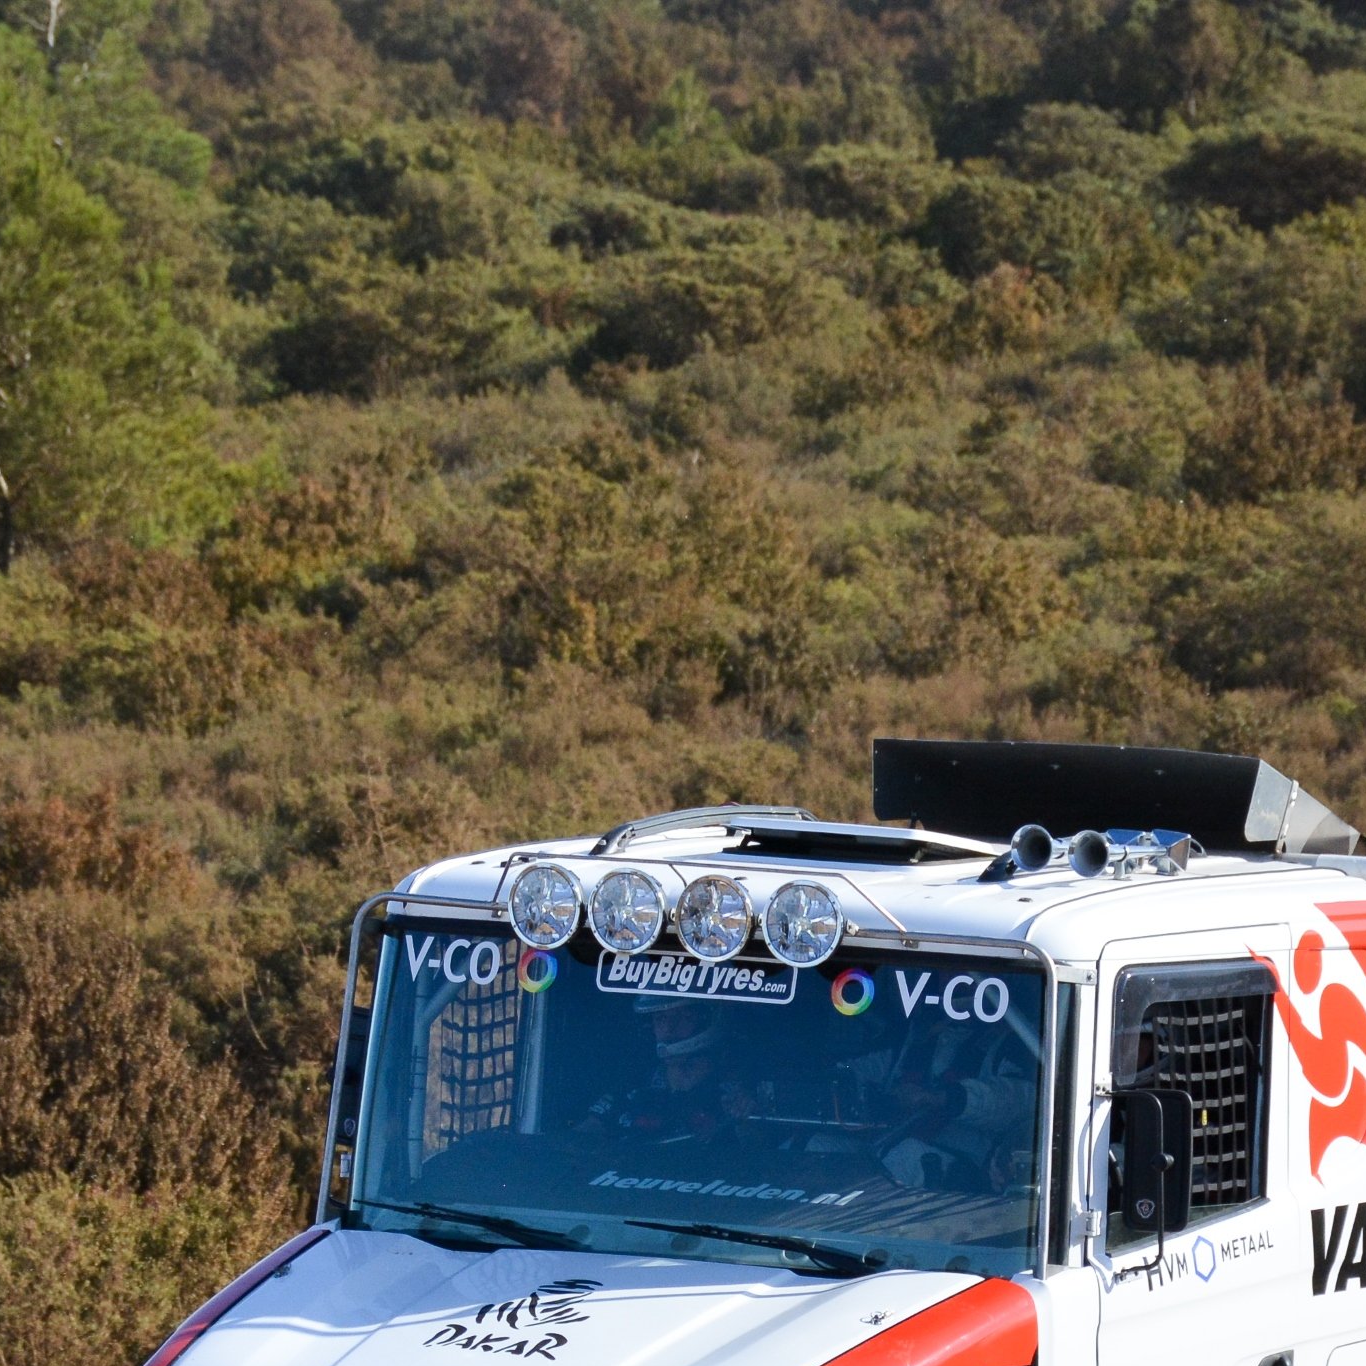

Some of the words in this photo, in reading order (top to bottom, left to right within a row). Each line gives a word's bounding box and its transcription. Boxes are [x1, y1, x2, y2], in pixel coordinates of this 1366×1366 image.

[405, 934, 501, 985] V-CO
[608, 953, 787, 995] BuyBigTyres.com
[895, 970, 1010, 1024] V-CO
[1142, 1252, 1189, 1292] HVM
[1220, 1230, 1274, 1263] METAAL
[422, 1323, 569, 1361] DAKAR
